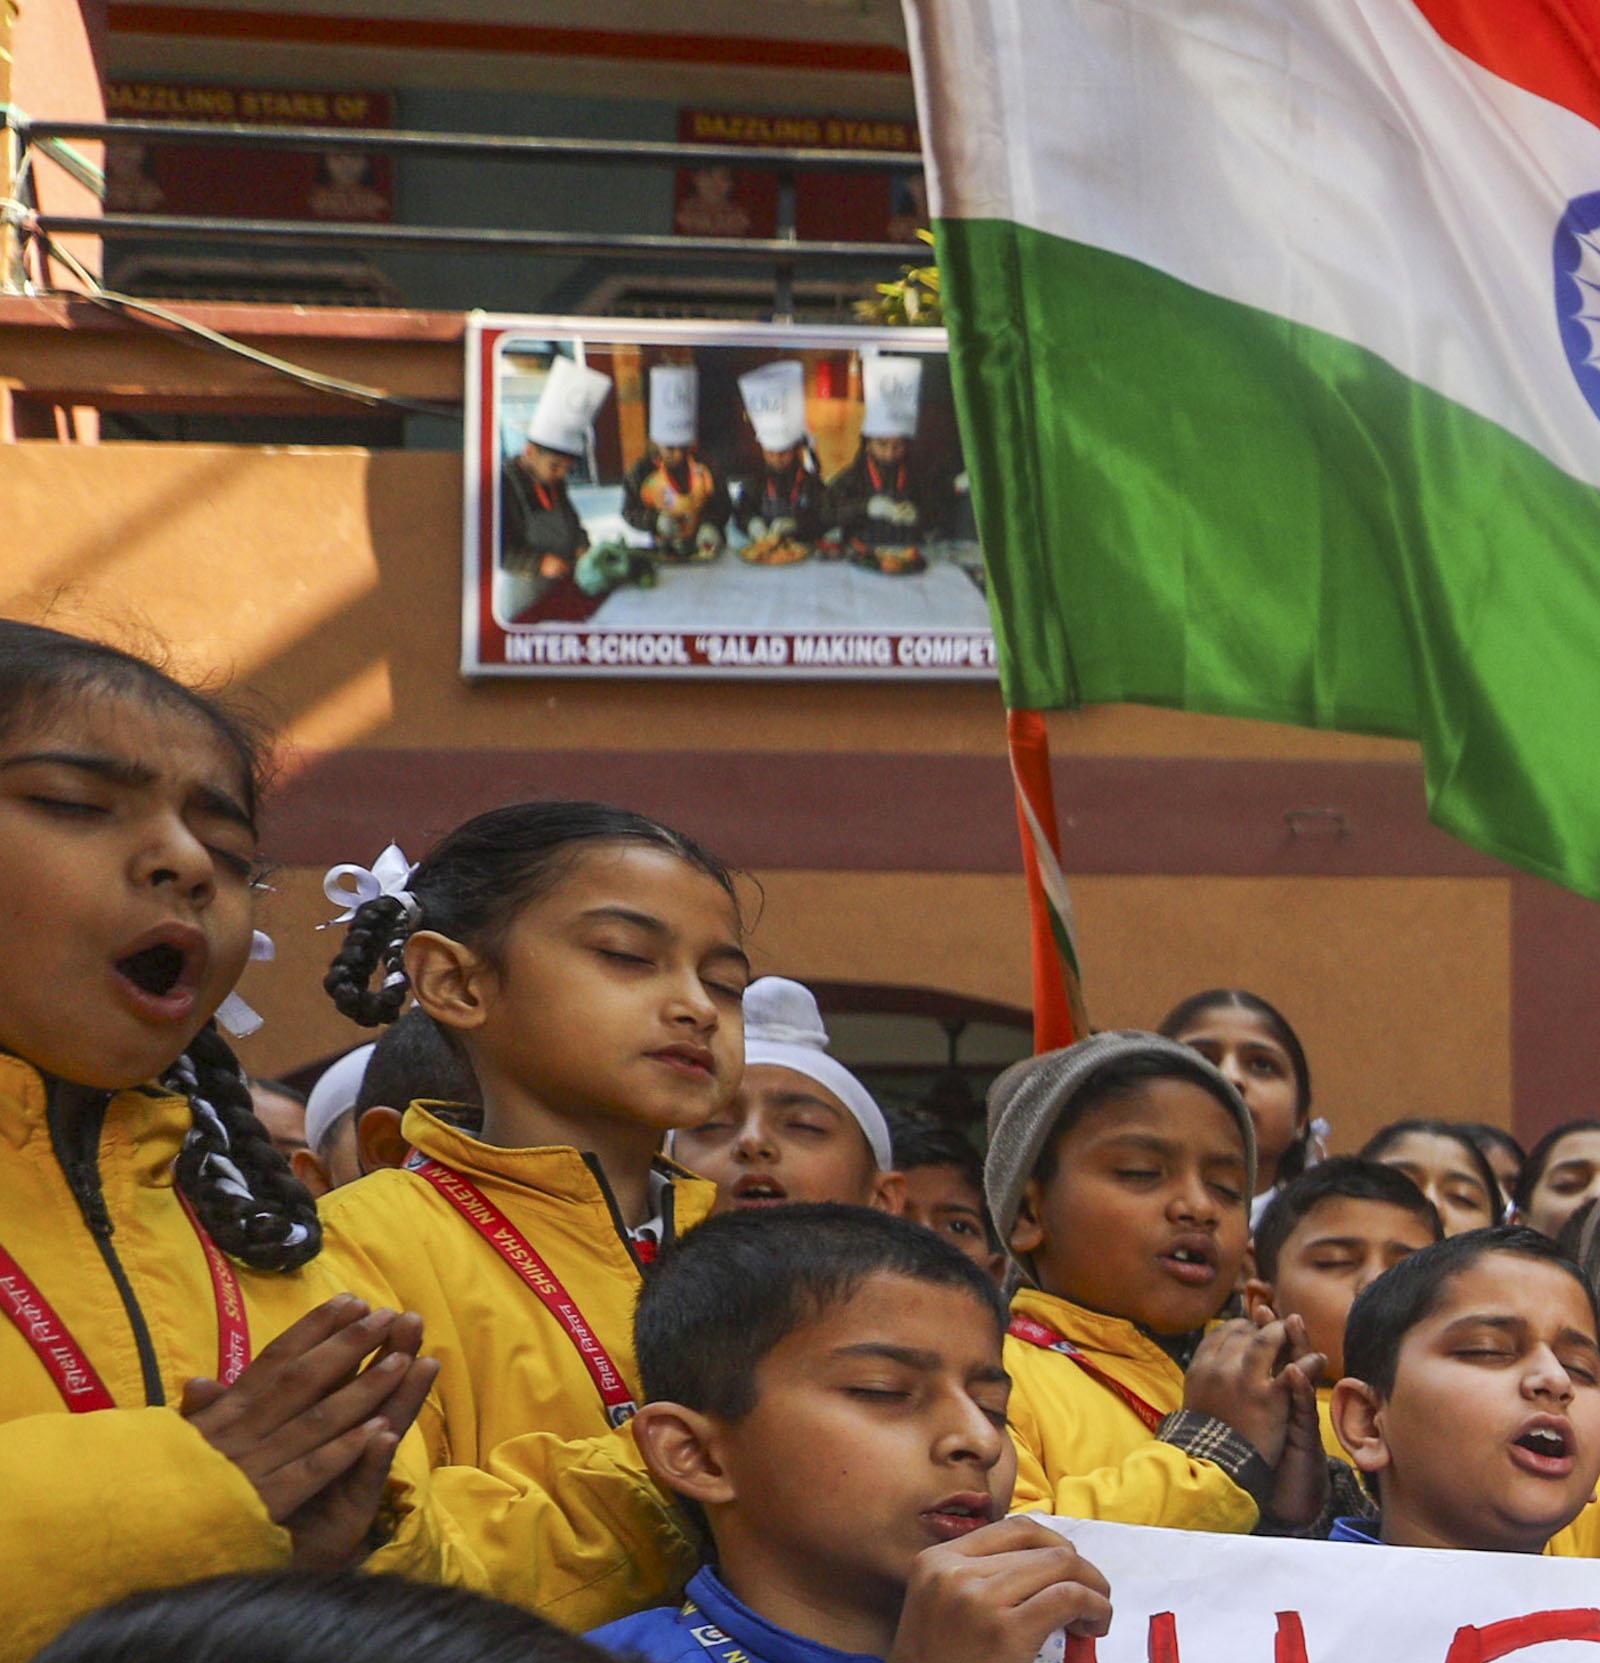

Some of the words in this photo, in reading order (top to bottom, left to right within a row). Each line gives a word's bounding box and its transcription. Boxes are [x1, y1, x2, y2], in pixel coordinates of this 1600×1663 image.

[239, 90, 327, 119] STARS
[334, 94, 368, 120] OF
[695, 113, 821, 140] DAZZLING
[827, 120, 907, 145] STARS
[504, 634, 690, 665] INTER-SCHOOL
[793, 636, 891, 666] MAKING
[898, 637, 997, 668] COMPET
[428, 1166, 495, 1226] NIKETAN
[493, 1227, 557, 1295] SHIKSHA
